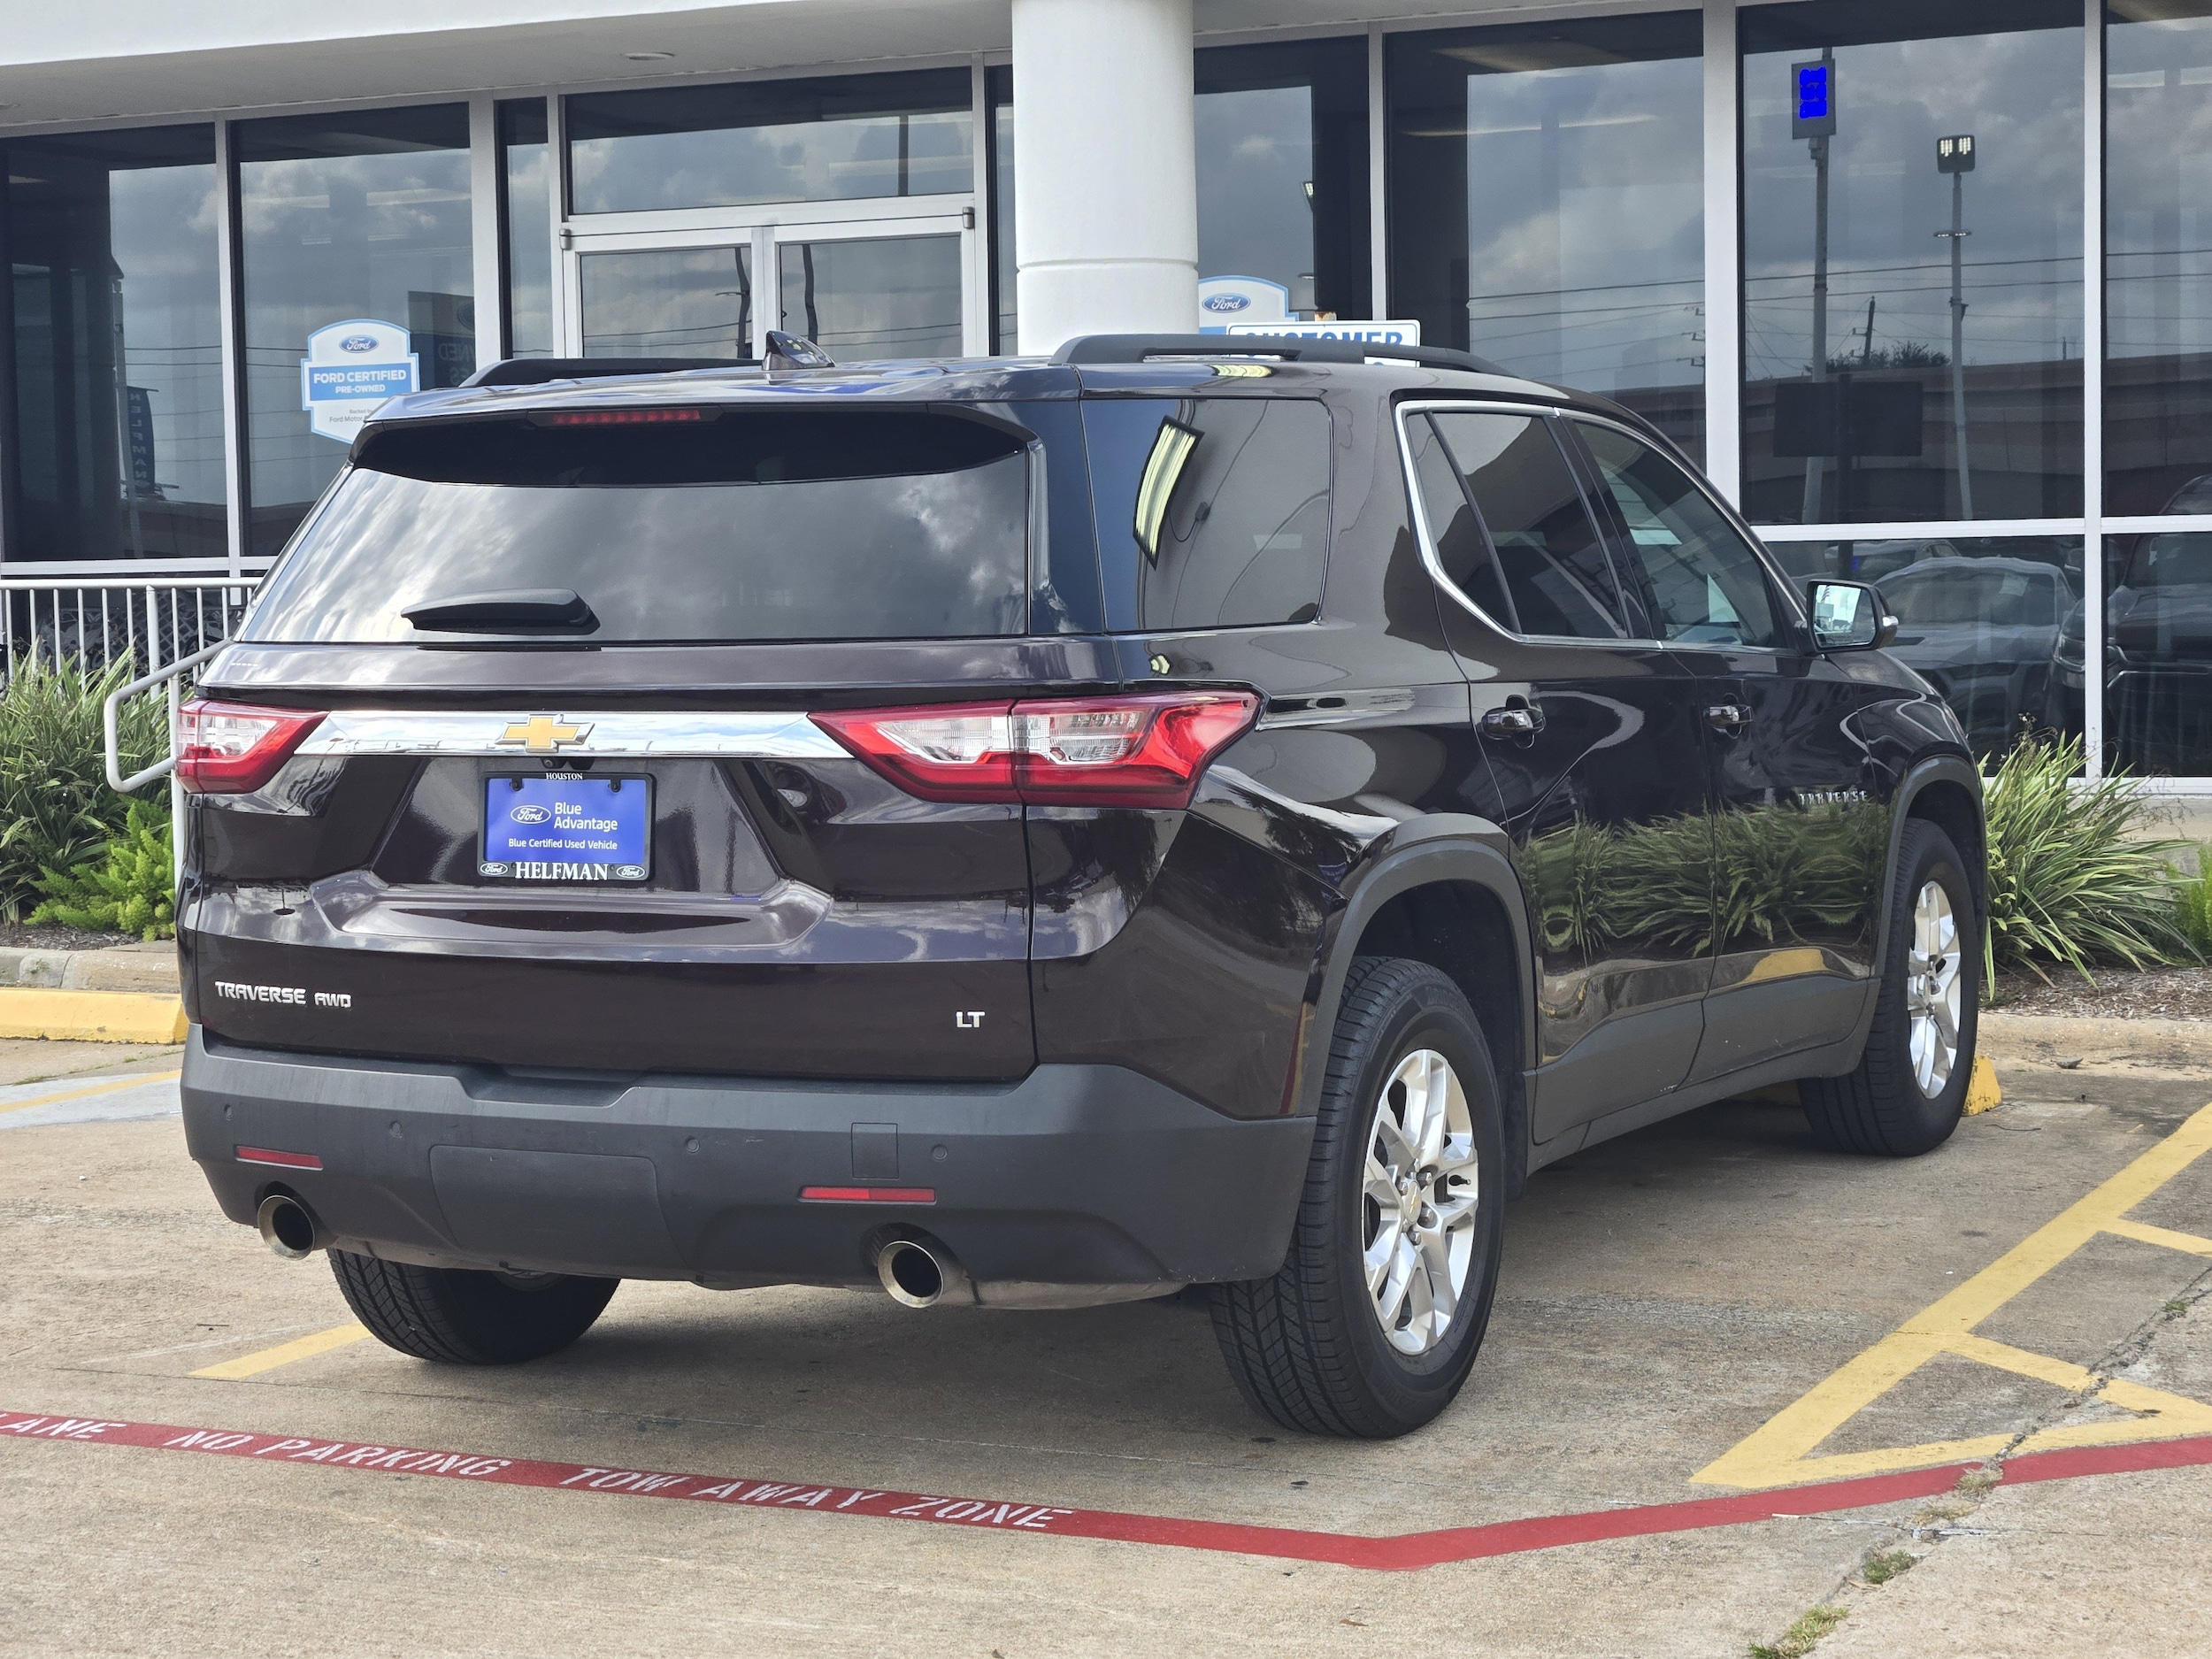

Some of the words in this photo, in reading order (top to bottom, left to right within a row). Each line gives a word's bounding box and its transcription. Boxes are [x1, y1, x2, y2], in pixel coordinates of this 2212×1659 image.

[1211, 296, 1240, 310] Ford
[346, 338, 371, 350] Ford
[313, 372, 346, 384] FORD
[347, 369, 407, 383] CERTIFIED
[335, 384, 386, 394] PRE-OWNED
[517, 807, 543, 821] Ford
[554, 802, 582, 815] Blue
[553, 816, 618, 833] Advantage
[508, 838, 527, 848] Blue
[528, 838, 563, 849] Certified
[565, 840, 585, 849] Used
[588, 841, 618, 850] Vehicle
[514, 861, 609, 881] HELFMAN
[215, 980, 307, 1005] TRAVERSE
[314, 991, 351, 1009] AWD
[956, 1011, 986, 1028] LT
[0, 1413, 127, 1439] ANE
[162, 1431, 255, 1450] NO
[253, 1439, 514, 1476] PARKING
[559, 1468, 691, 1492] TOW
[689, 1481, 886, 1509] AWAY
[888, 1496, 1075, 1529] ZONE
